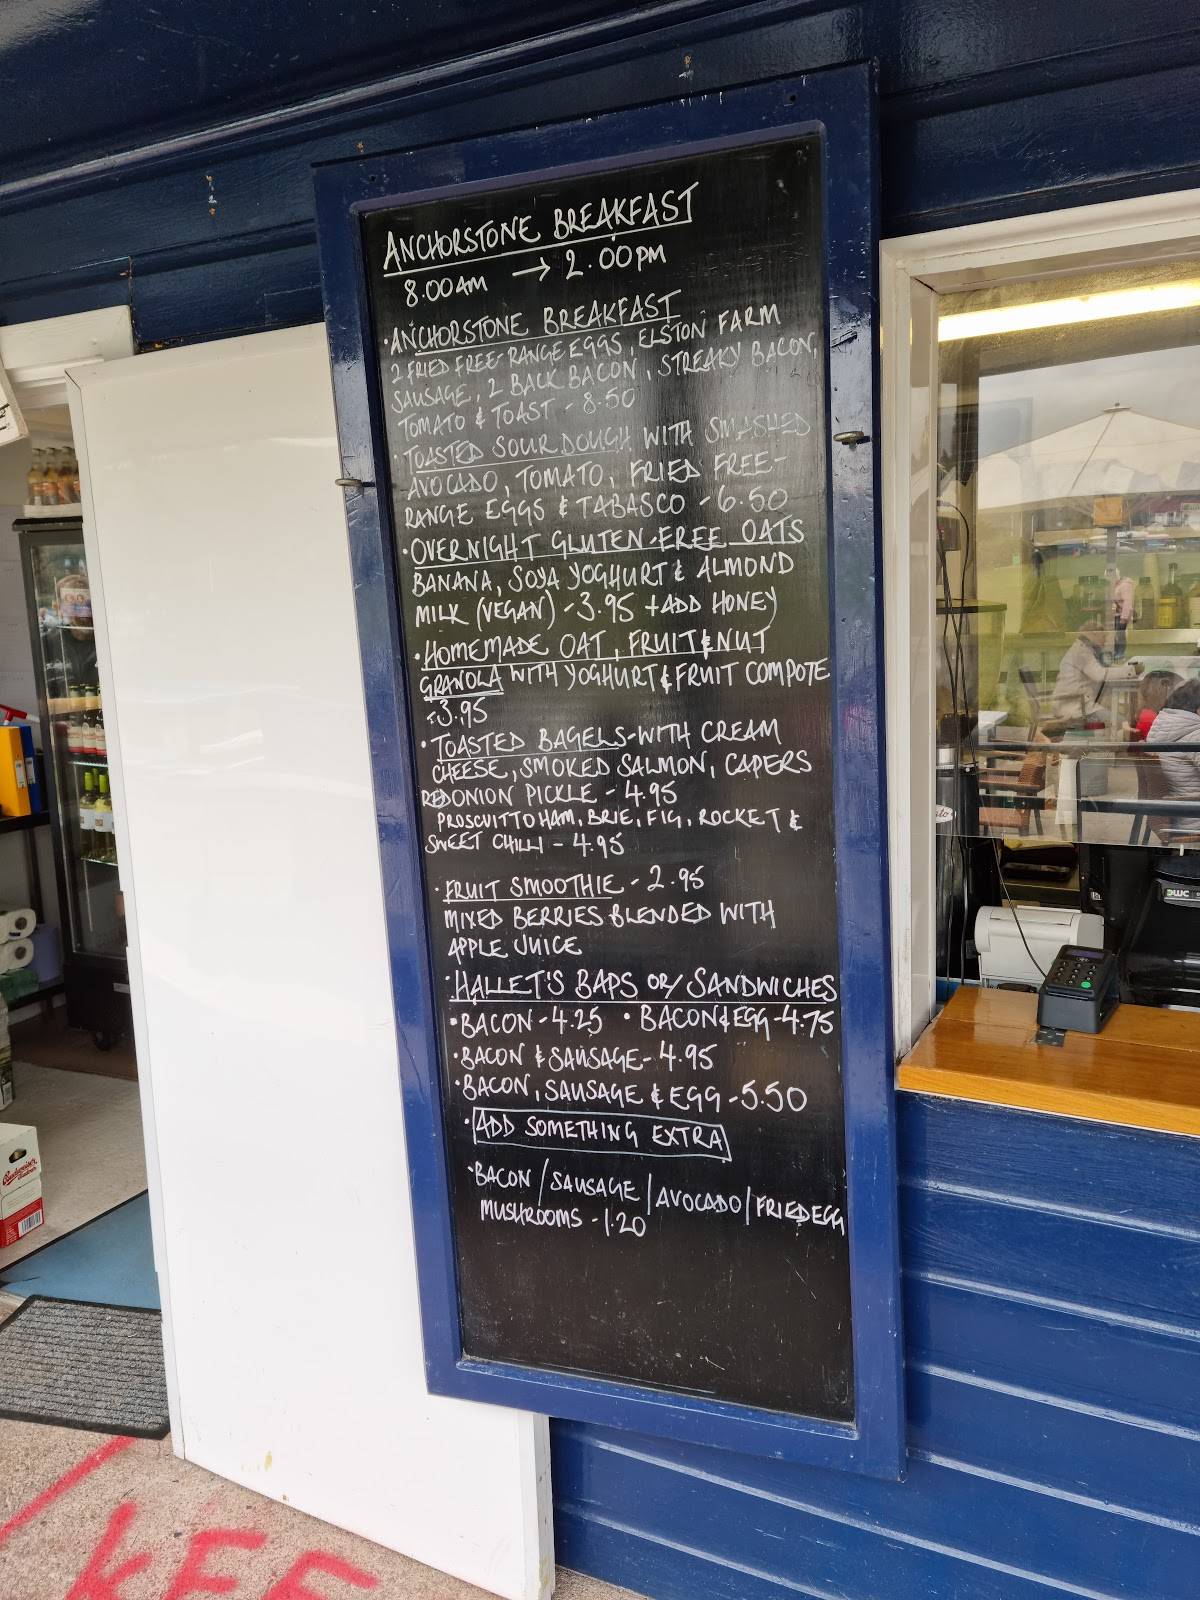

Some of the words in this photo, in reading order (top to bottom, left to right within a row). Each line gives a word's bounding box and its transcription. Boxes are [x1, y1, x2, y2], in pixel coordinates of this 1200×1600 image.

[383, 216, 541, 271] ANCHORSTONE
[554, 182, 699, 240] BREAKFAST
[405, 276, 488, 307] 8.00AM
[391, 313, 529, 355] ANCHORSTONE
[544, 289, 681, 335] BREAKFAST
[407, 358, 449, 385] FRIED
[639, 318, 706, 348] ELSTON
[718, 304, 781, 335] FARM
[488, 378, 503, 398] 2
[510, 368, 564, 396] BACK
[658, 342, 741, 377] STREAKY
[398, 412, 466, 441] TOMATO
[491, 398, 555, 429] TOAST
[404, 440, 484, 474] TOASTED
[644, 420, 693, 450] WITH
[705, 412, 811, 443] SMASHED
[630, 458, 700, 487] FRIED
[405, 503, 473, 528] RANGE
[486, 498, 545, 526] EGGS
[576, 492, 686, 519] TABASCO
[410, 533, 541, 565] OVERNIGHT
[742, 514, 805, 545] OATS
[412, 569, 502, 597] BANANA,
[508, 565, 560, 592] SOYA
[567, 561, 668, 592] YOGHURT
[697, 551, 794, 582] ALMOND
[415, 603, 469, 627] MILK
[477, 589, 555, 632] (VEGAN)
[424, 634, 549, 669] HOMEMADE
[420, 664, 504, 700] GRANOLA
[509, 662, 558, 687] WITH
[746, 657, 831, 687] COMPOTE
[431, 731, 525, 763] TOASTED
[701, 718, 782, 745] CREAM
[519, 755, 611, 778] SMOKED
[617, 751, 715, 779] SALMON,
[725, 750, 812, 779] CAPERS
[525, 783, 597, 806] PICKLE
[699, 808, 780, 833] ROCKET
[425, 831, 483, 853] SWEET
[492, 834, 544, 854] CHILLI
[446, 880, 500, 902] FRUIT
[510, 873, 625, 898] SMOOTHIE
[444, 908, 503, 933] MIXED
[513, 905, 603, 930] BERRIES
[610, 902, 711, 928] BLENDED
[720, 900, 776, 928] WITH
[448, 938, 508, 965] APPLE
[513, 934, 582, 956] JUICE
[455, 969, 565, 1000] HALLET'S
[575, 968, 638, 1000] BAPS
[686, 966, 838, 1001] SANDWICHES
[461, 1008, 533, 1039] BACON
[460, 1042, 526, 1071] BACON
[544, 1079, 643, 1108] SAUSAGE
[669, 1085, 721, 1113] EGG
[476, 1109, 515, 1139] ADD
[524, 1116, 638, 1148] SOMETHING
[652, 1124, 723, 1151] EXTRA
[480, 1199, 583, 1229] MUSHROOMS
